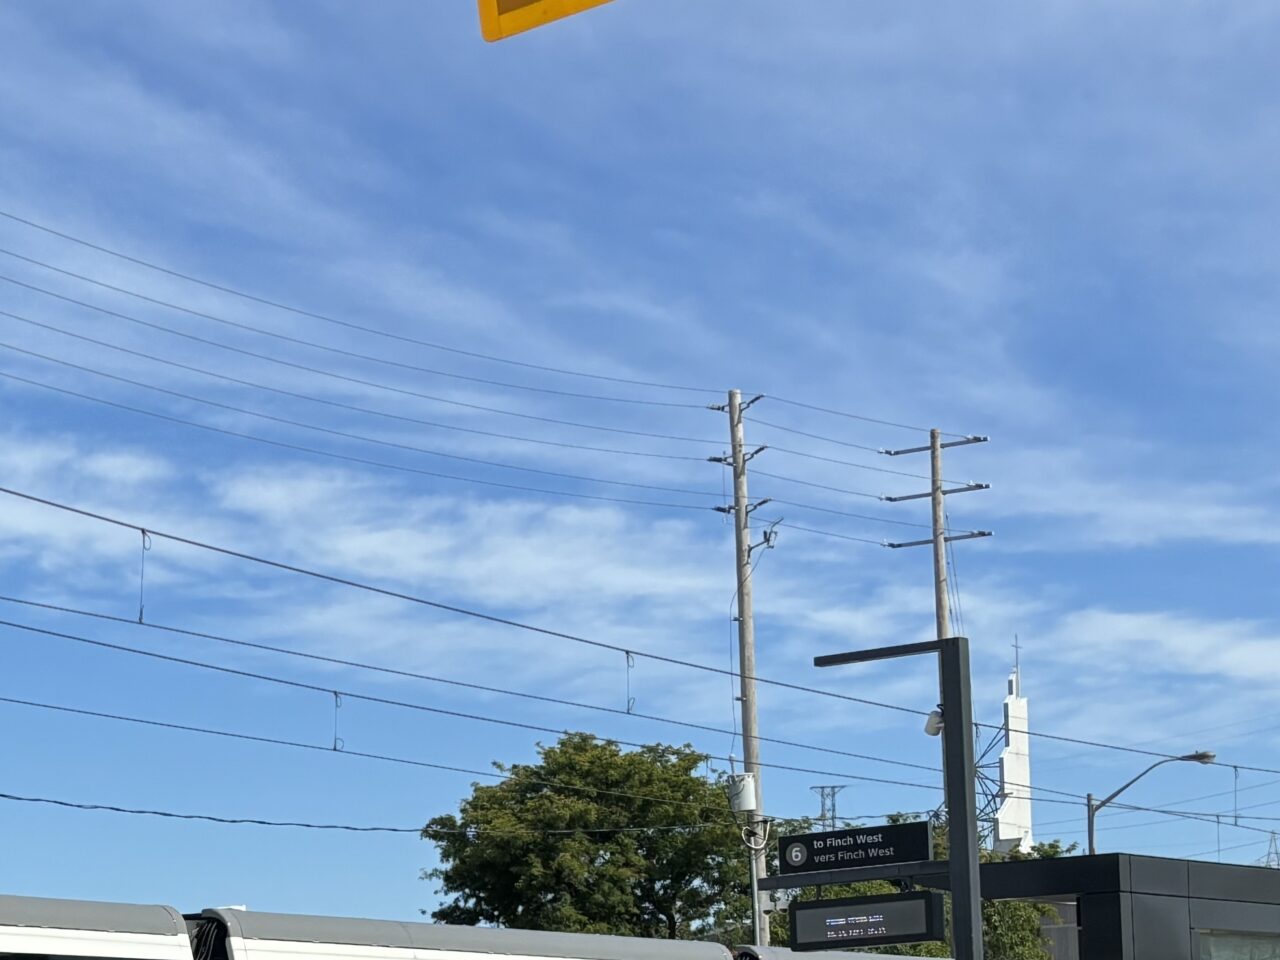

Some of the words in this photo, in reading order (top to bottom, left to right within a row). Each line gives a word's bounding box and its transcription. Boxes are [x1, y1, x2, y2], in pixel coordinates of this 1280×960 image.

[813, 839, 824, 849] to
[826, 836, 853, 848] Finch
[855, 833, 883, 844] West
[791, 847, 802, 862] 6
[813, 853, 835, 863] vers
[838, 849, 865, 861] Finch
[867, 846, 895, 858] West
